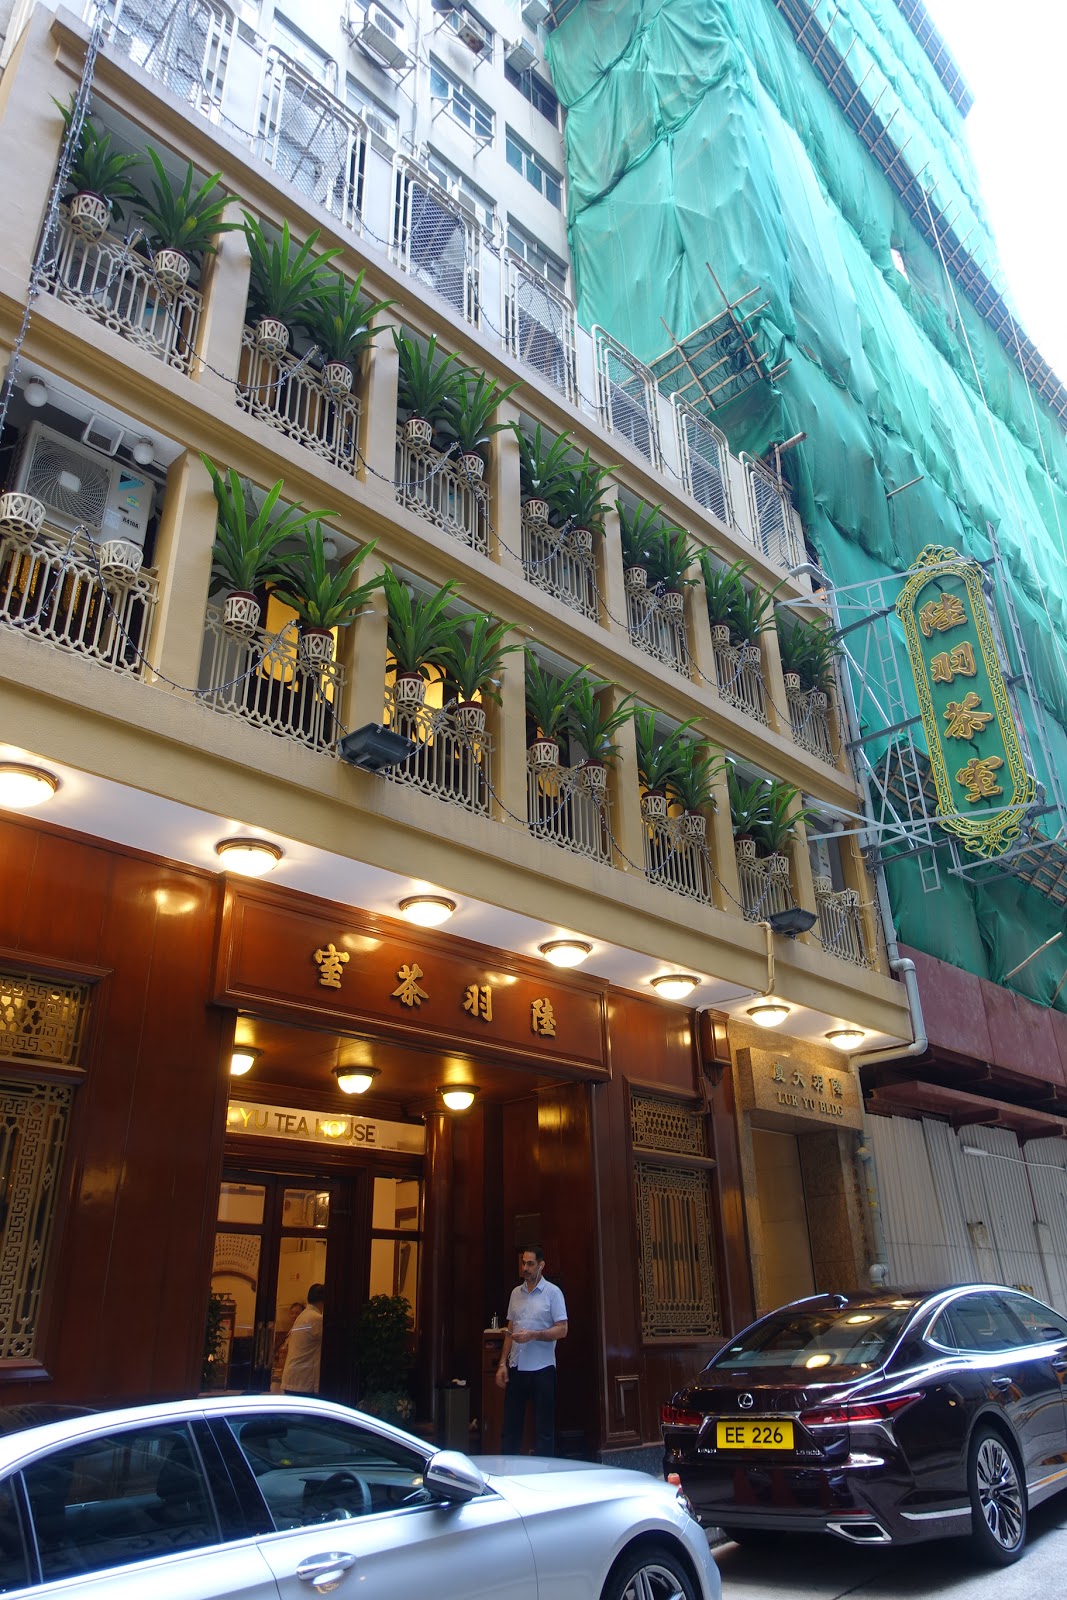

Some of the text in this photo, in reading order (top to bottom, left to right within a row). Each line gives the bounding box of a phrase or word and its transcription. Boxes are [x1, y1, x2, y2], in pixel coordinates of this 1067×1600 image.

[919, 592, 1004, 803] 陸羽茶室
[776, 1092, 843, 1117] LUK YU BLDG
[239, 1107, 268, 1129] YU
[274, 1112, 310, 1136] TEA
[315, 1117, 376, 1143] HOUSE
[725, 1426, 784, 1444] EE 226
